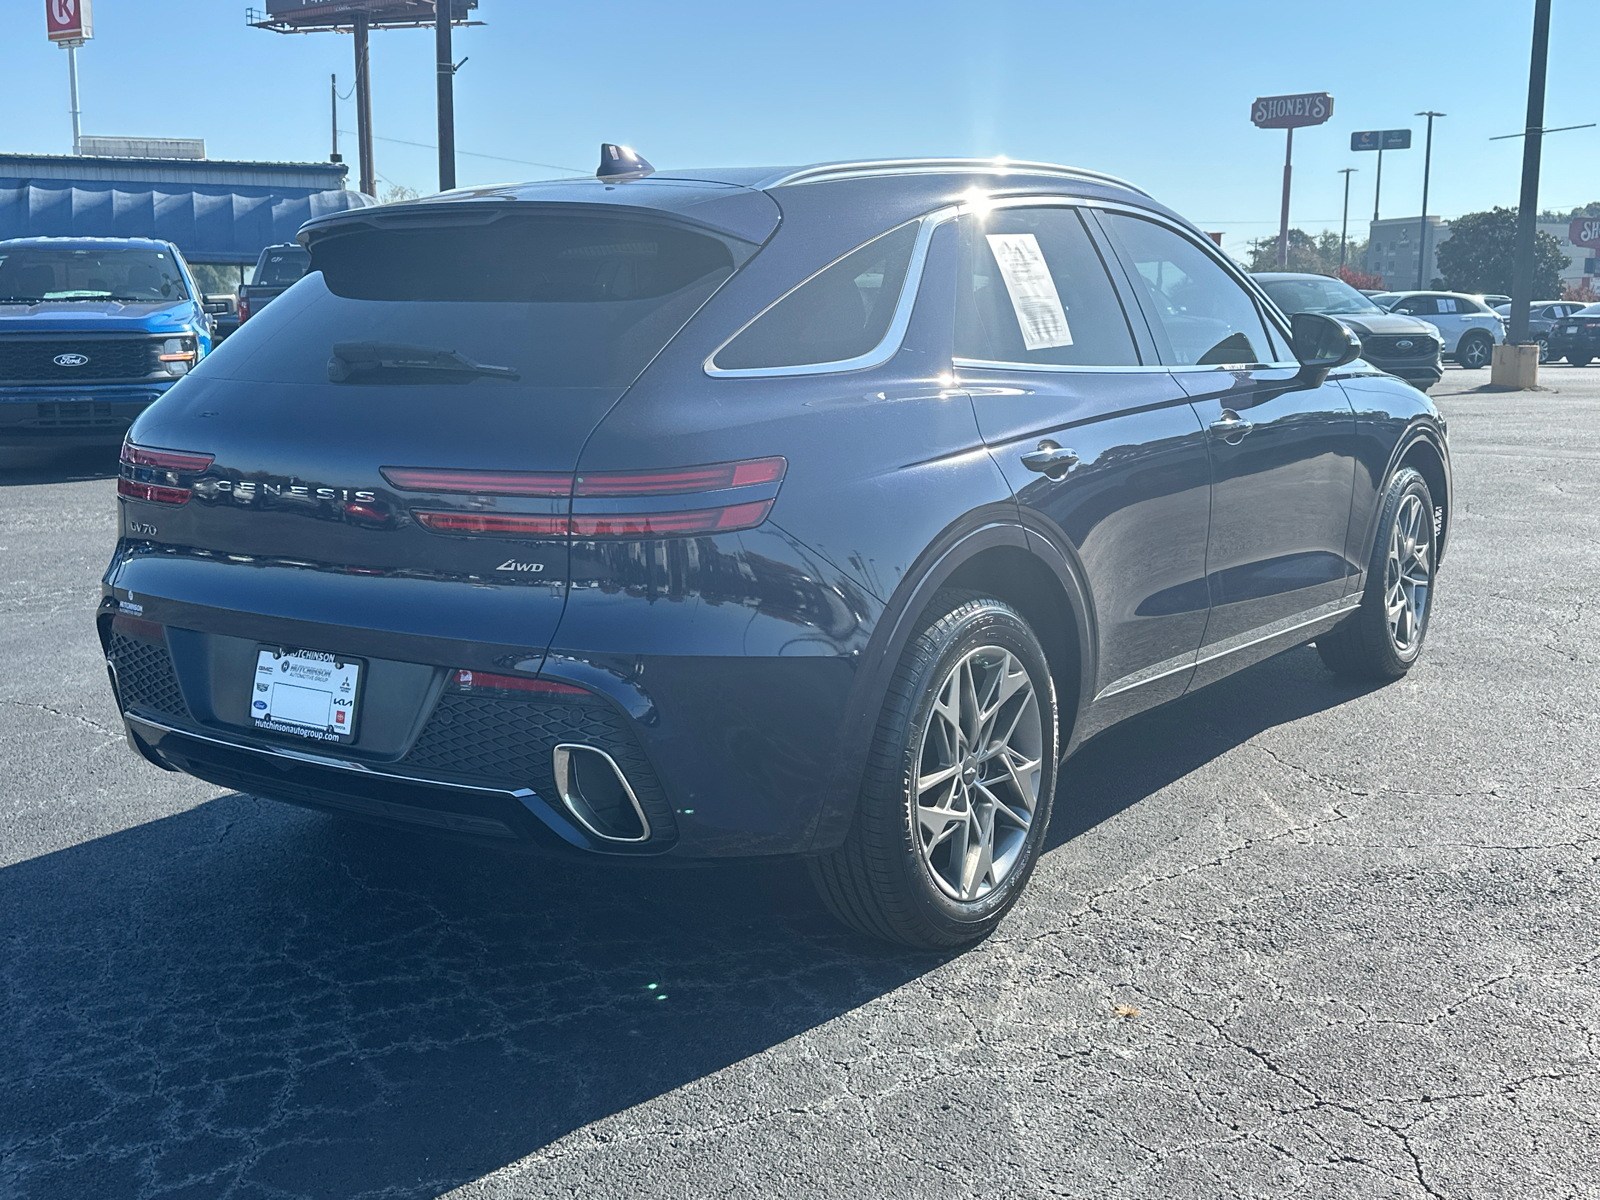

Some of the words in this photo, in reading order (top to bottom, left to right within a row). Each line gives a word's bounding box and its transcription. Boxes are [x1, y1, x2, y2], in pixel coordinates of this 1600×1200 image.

[1255, 95, 1325, 122] SHONEY'S
[1580, 221, 1600, 242] SH
[58, 354, 83, 365] Ford
[215, 480, 376, 503] GENESIS
[130, 520, 157, 536] GV70
[254, 719, 340, 742] Hutchinsonautogroup.com
